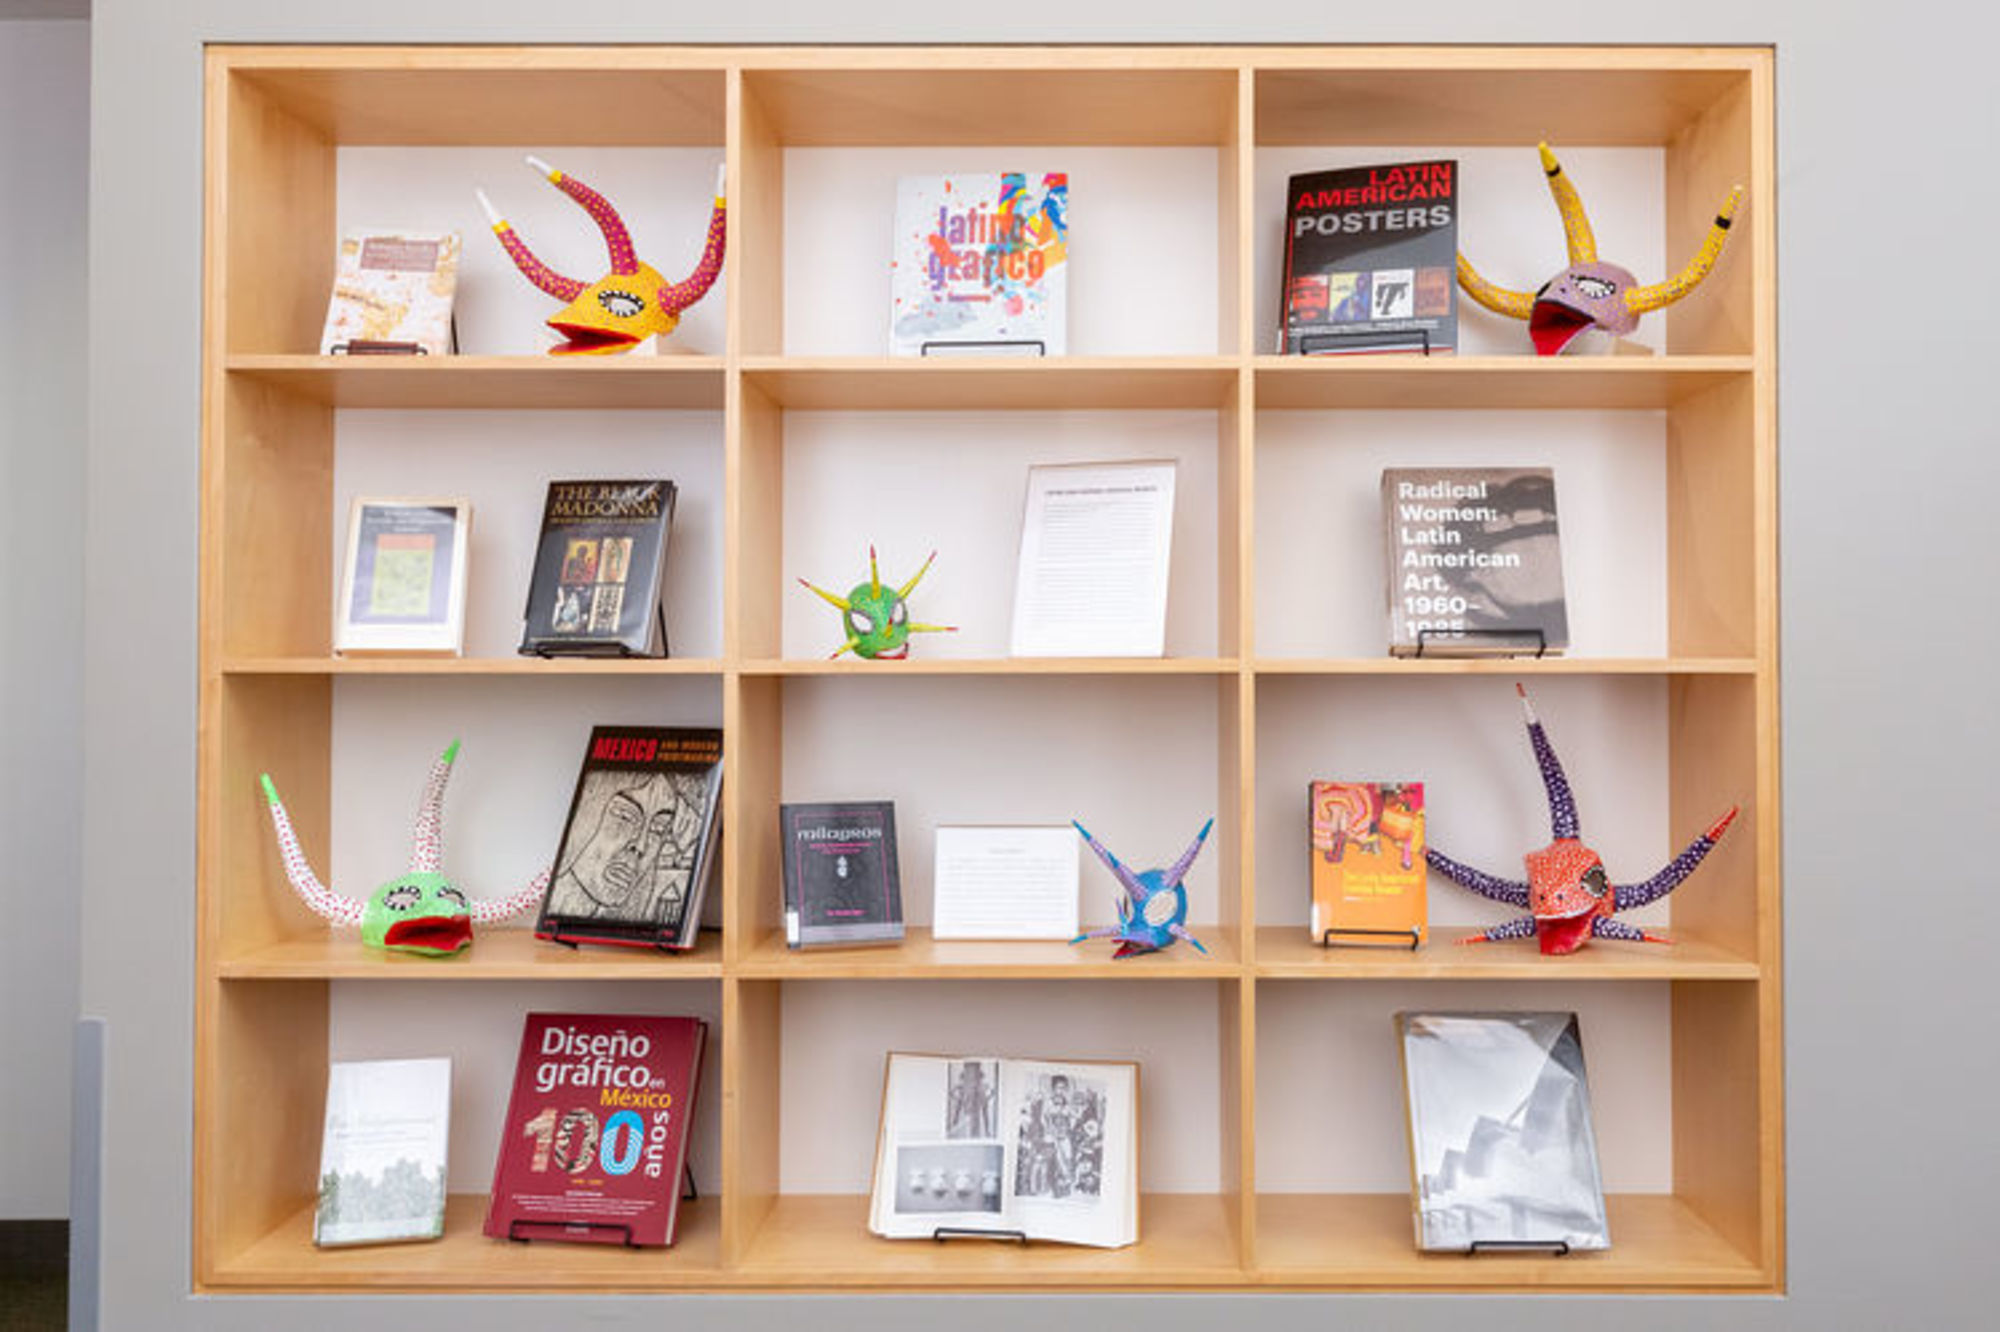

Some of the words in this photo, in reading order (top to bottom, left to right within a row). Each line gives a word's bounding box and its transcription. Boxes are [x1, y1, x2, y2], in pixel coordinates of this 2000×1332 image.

[1369, 164, 1451, 186] LATIN
[1296, 180, 1451, 211] AMERICAN
[939, 205, 1026, 244] latino
[1294, 204, 1451, 239] POSTERS
[555, 485, 595, 501] THE
[1400, 480, 1488, 500] Radical
[550, 500, 659, 517] MADONNA
[1400, 504, 1498, 523] Women:
[1401, 526, 1462, 545] Latin
[1403, 549, 1521, 568] American
[1404, 573, 1449, 593] Art,
[592, 737, 659, 762] MEXICO
[797, 826, 882, 842] milagros
[540, 1026, 651, 1059] Diseño
[535, 1057, 651, 1093] gráfico
[600, 1087, 672, 1109] México
[523, 1107, 645, 1175] 100
[645, 1110, 671, 1179] años
